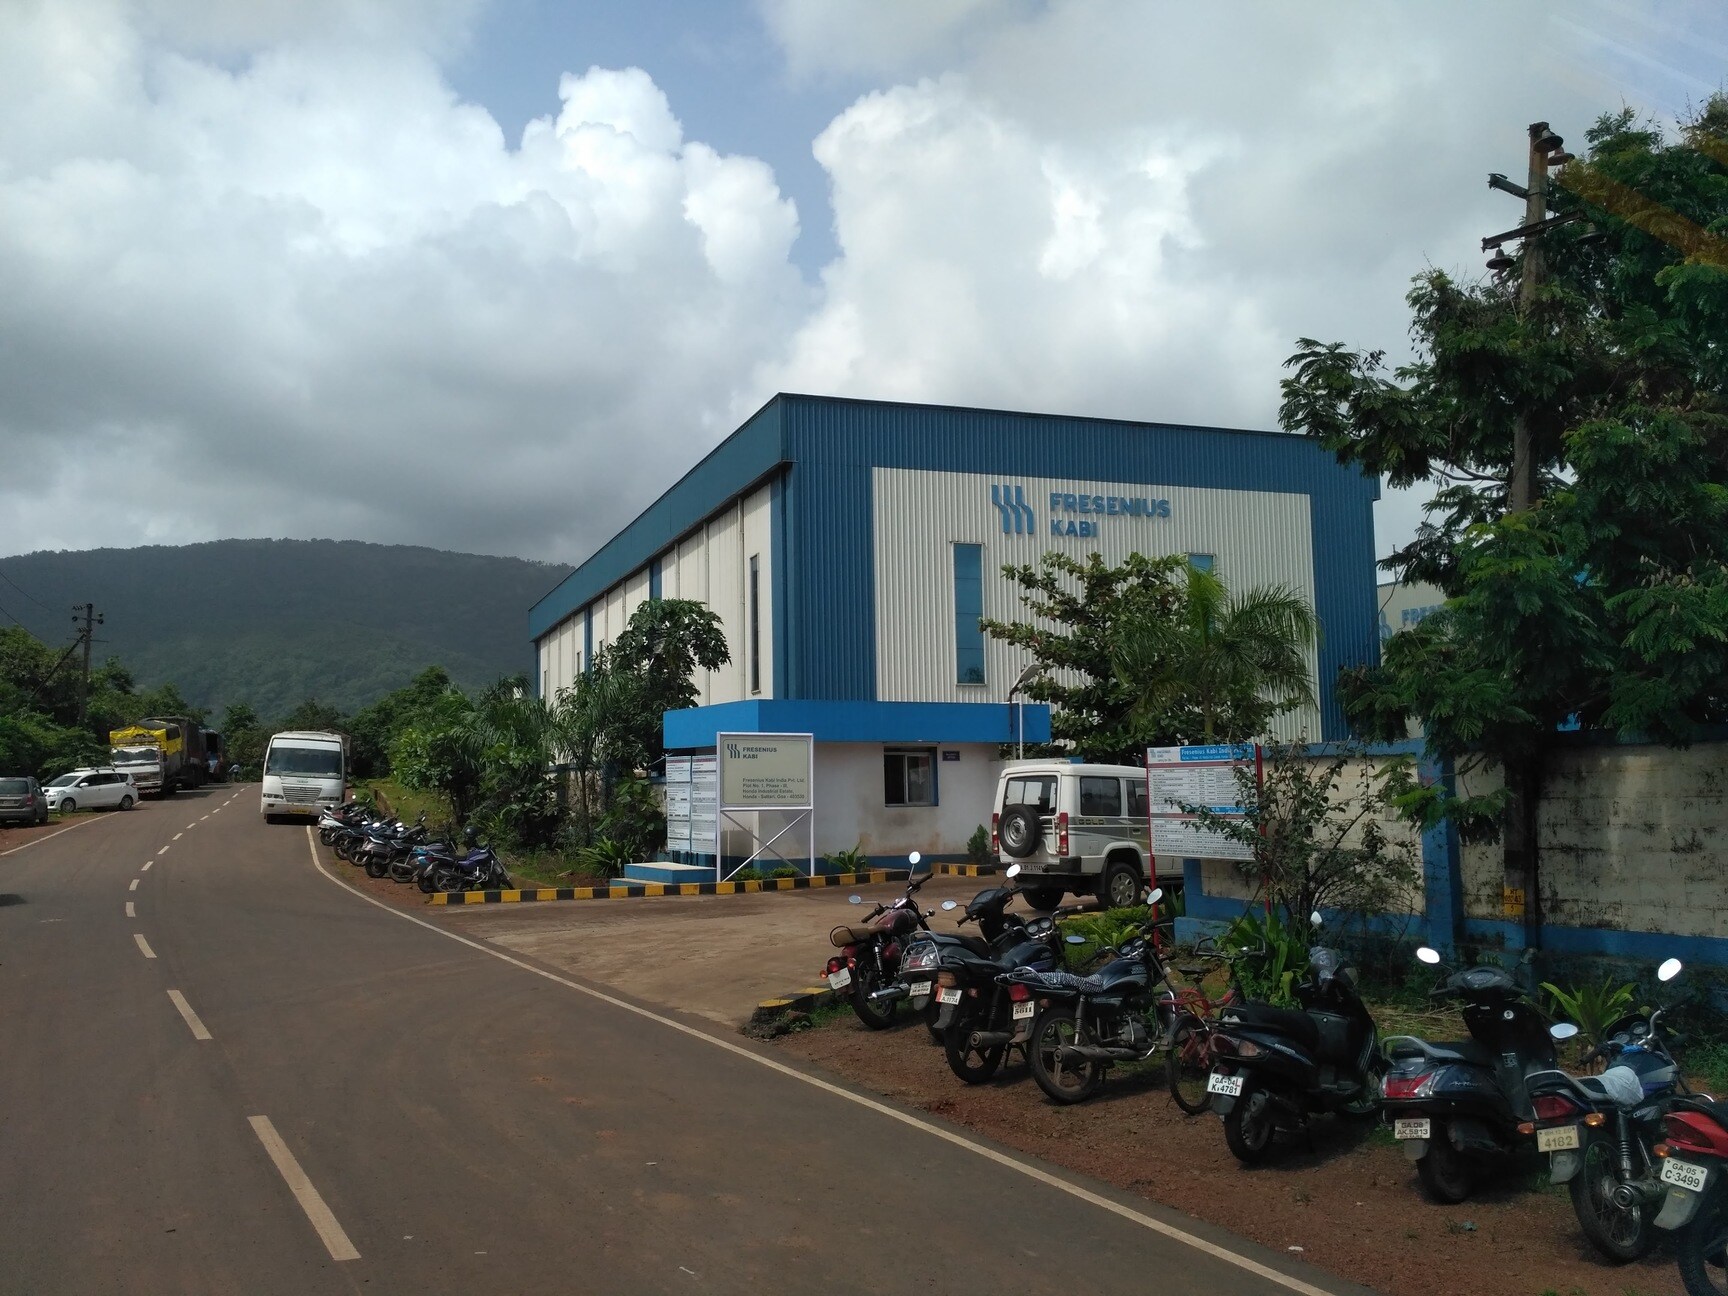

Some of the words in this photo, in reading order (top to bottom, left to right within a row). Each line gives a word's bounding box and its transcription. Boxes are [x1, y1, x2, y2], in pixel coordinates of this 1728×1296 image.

[1049, 492, 1171, 518] FRESENIUS
[1050, 519, 1097, 538] KABI
[1544, 1135, 1573, 1149] 4182
